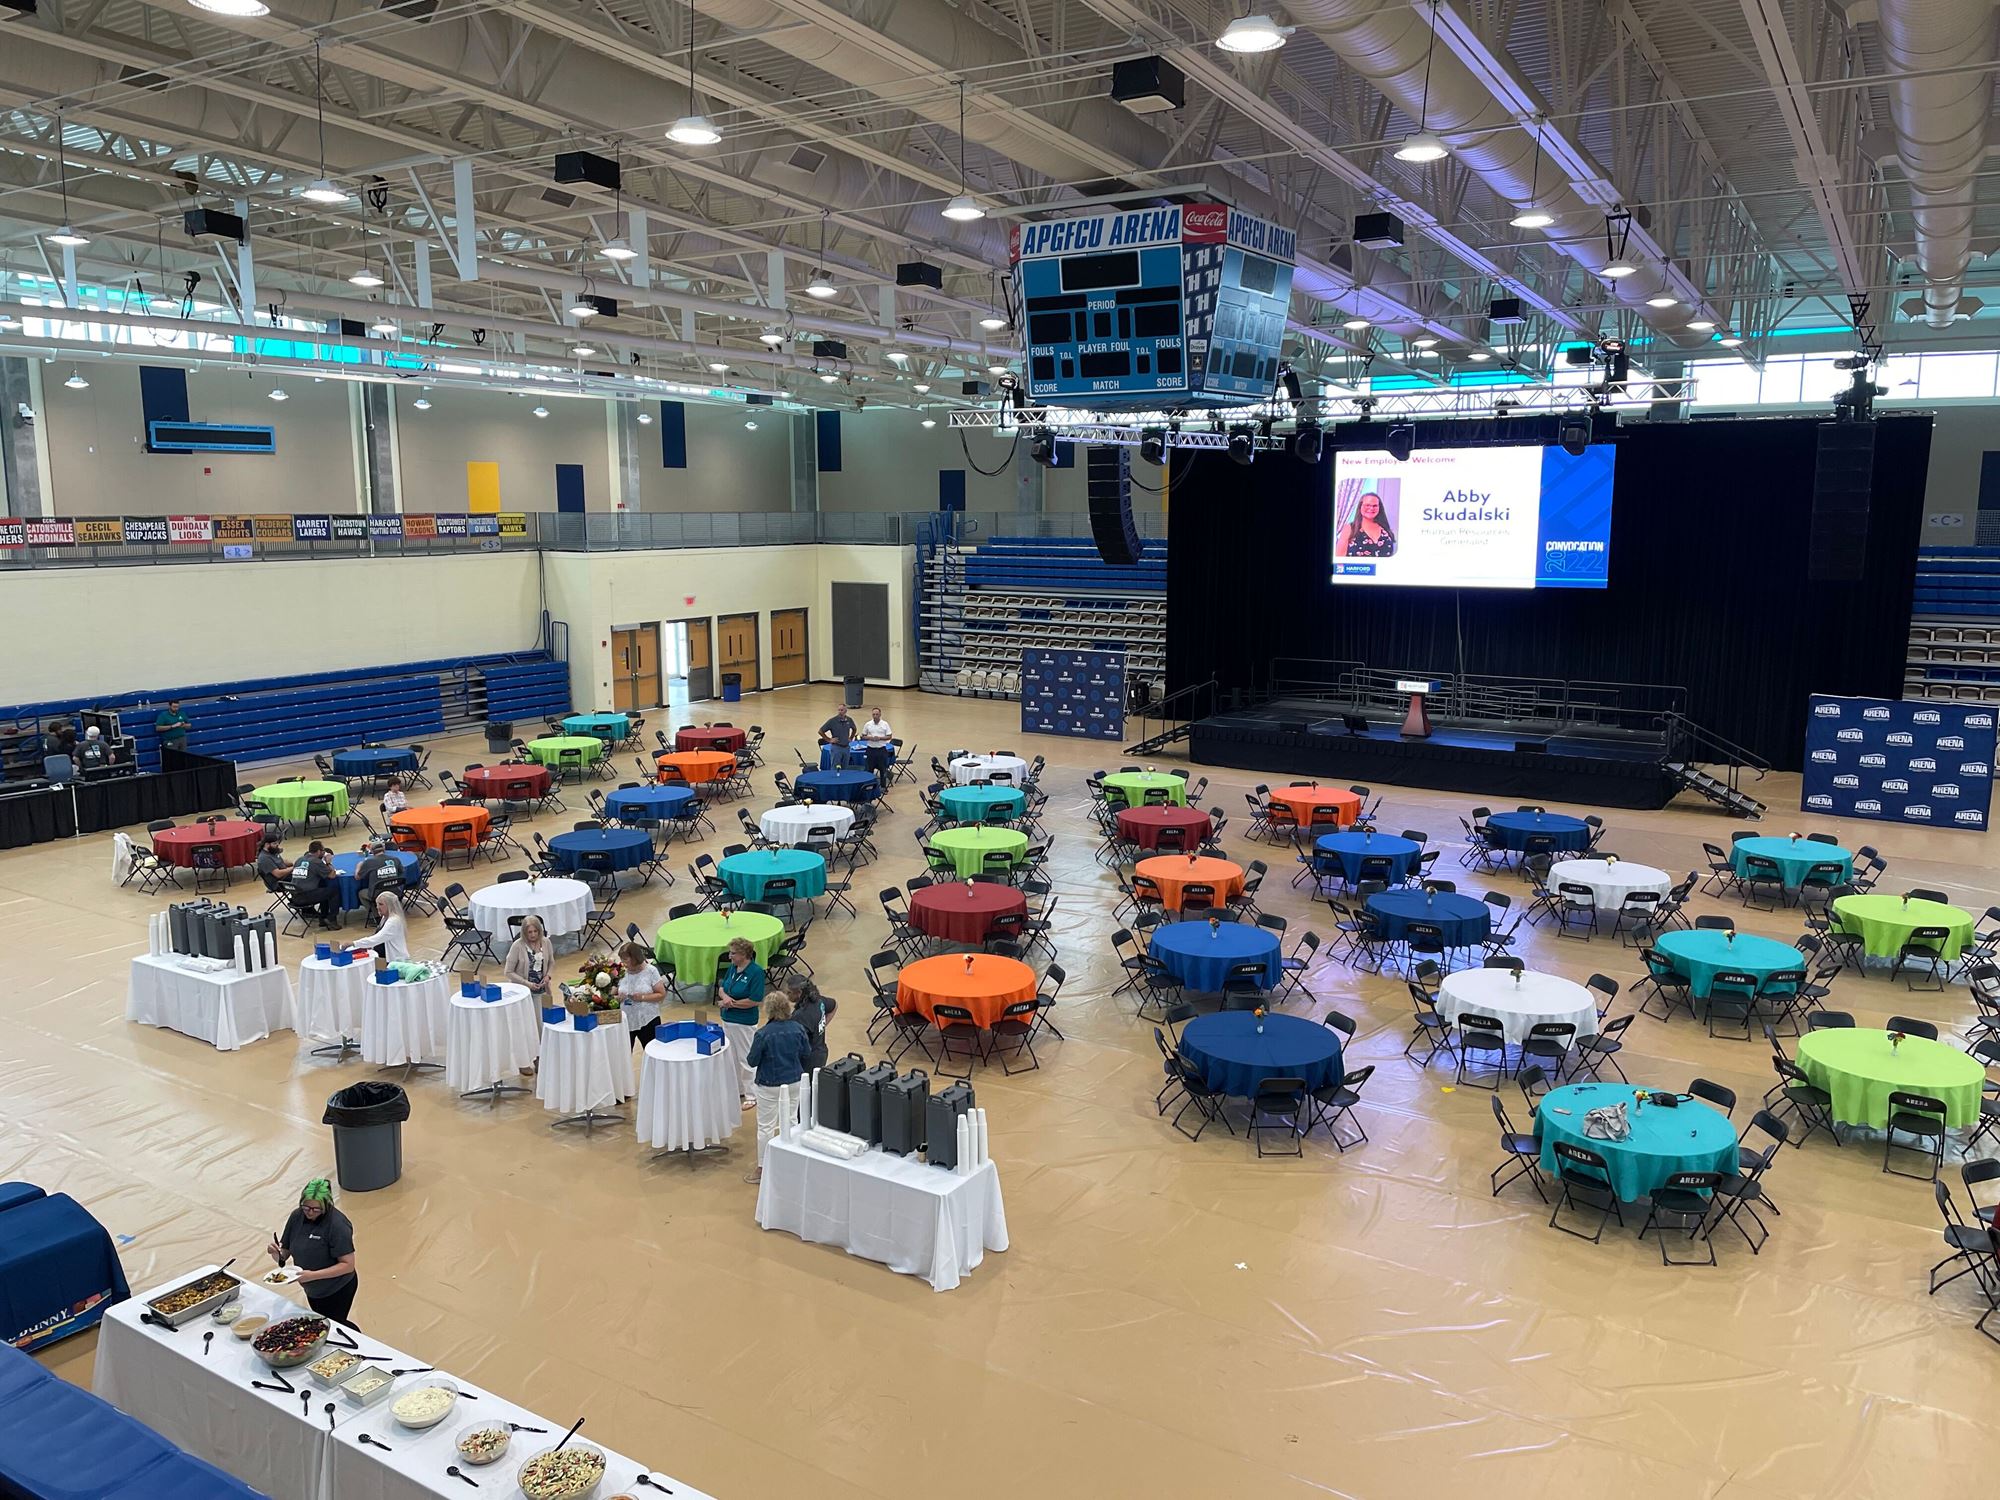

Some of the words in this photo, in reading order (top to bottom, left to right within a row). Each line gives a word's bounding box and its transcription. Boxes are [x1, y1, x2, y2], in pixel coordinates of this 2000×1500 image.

[1023, 218, 1104, 255] APGFCU
[1109, 208, 1180, 245] ARENA
[1228, 212, 1265, 250] APGFCU
[1267, 226, 1295, 260] ARENA
[1087, 300, 1115, 311] PERIOD
[1078, 343, 1107, 354] PLAYER
[1111, 341, 1130, 351] FOUL
[1155, 337, 1181, 348] FOULS
[1031, 346, 1055, 356] FOULS
[1092, 380, 1120, 390] MATCH
[1156, 377, 1182, 387] SCORE
[1034, 383, 1057, 393] SCORE
[1365, 457, 1409, 466] Employ
[1443, 489, 1491, 506] Abby
[1422, 507, 1510, 521] Skudalski
[26, 523, 73, 533] CATONSVILLE
[86, 523, 112, 531] CECIL
[125, 521, 166, 531] CHESAPEAKE
[171, 522, 209, 531] DUNDALK
[221, 521, 245, 529] ESSEX
[255, 520, 292, 529] FREDERICK
[296, 520, 328, 528] GARRETT
[369, 519, 400, 527] HARFORD
[9, 524, 22, 534] CITY
[217, 529, 250, 538] KNIGHTS
[256, 529, 292, 537] COUGARS
[300, 528, 327, 537] LAKERS
[338, 528, 362, 536] HAWKS
[438, 525, 466, 533] RAPTORS
[27, 533, 74, 544] CARDINALS
[78, 532, 121, 541] SEAHAWKS
[126, 531, 167, 540] SKIPJACKS
[179, 531, 203, 539] LIONS
[1545, 541, 1604, 552] CONVOCATION
[1815, 706, 1841, 715] ARENA
[1863, 709, 1890, 719] ARENA
[1913, 713, 1941, 722] ARENA
[1964, 717, 1992, 727] ARENA
[1837, 731, 1863, 740] ARENA
[1886, 734, 1913, 744] ARENA
[1936, 738, 1964, 748] ARENA
[1812, 752, 1837, 761] ARENA
[1859, 756, 1886, 765] ARENA
[1909, 760, 1936, 770] ARENA
[1960, 764, 1988, 774] ARENA
[1833, 777, 1859, 786] ARENA
[1882, 781, 1908, 791] ARENA
[1932, 786, 1959, 796] ARENA
[1807, 797, 1833, 806] ARENA
[1855, 802, 1881, 812] ARENA
[1904, 807, 1931, 817] ARENA
[1955, 812, 1982, 822] ARENA
[377, 866, 397, 876] ARENA
[1568, 1148, 1592, 1161] ARENA
[1680, 1176, 1705, 1184] ARENA
